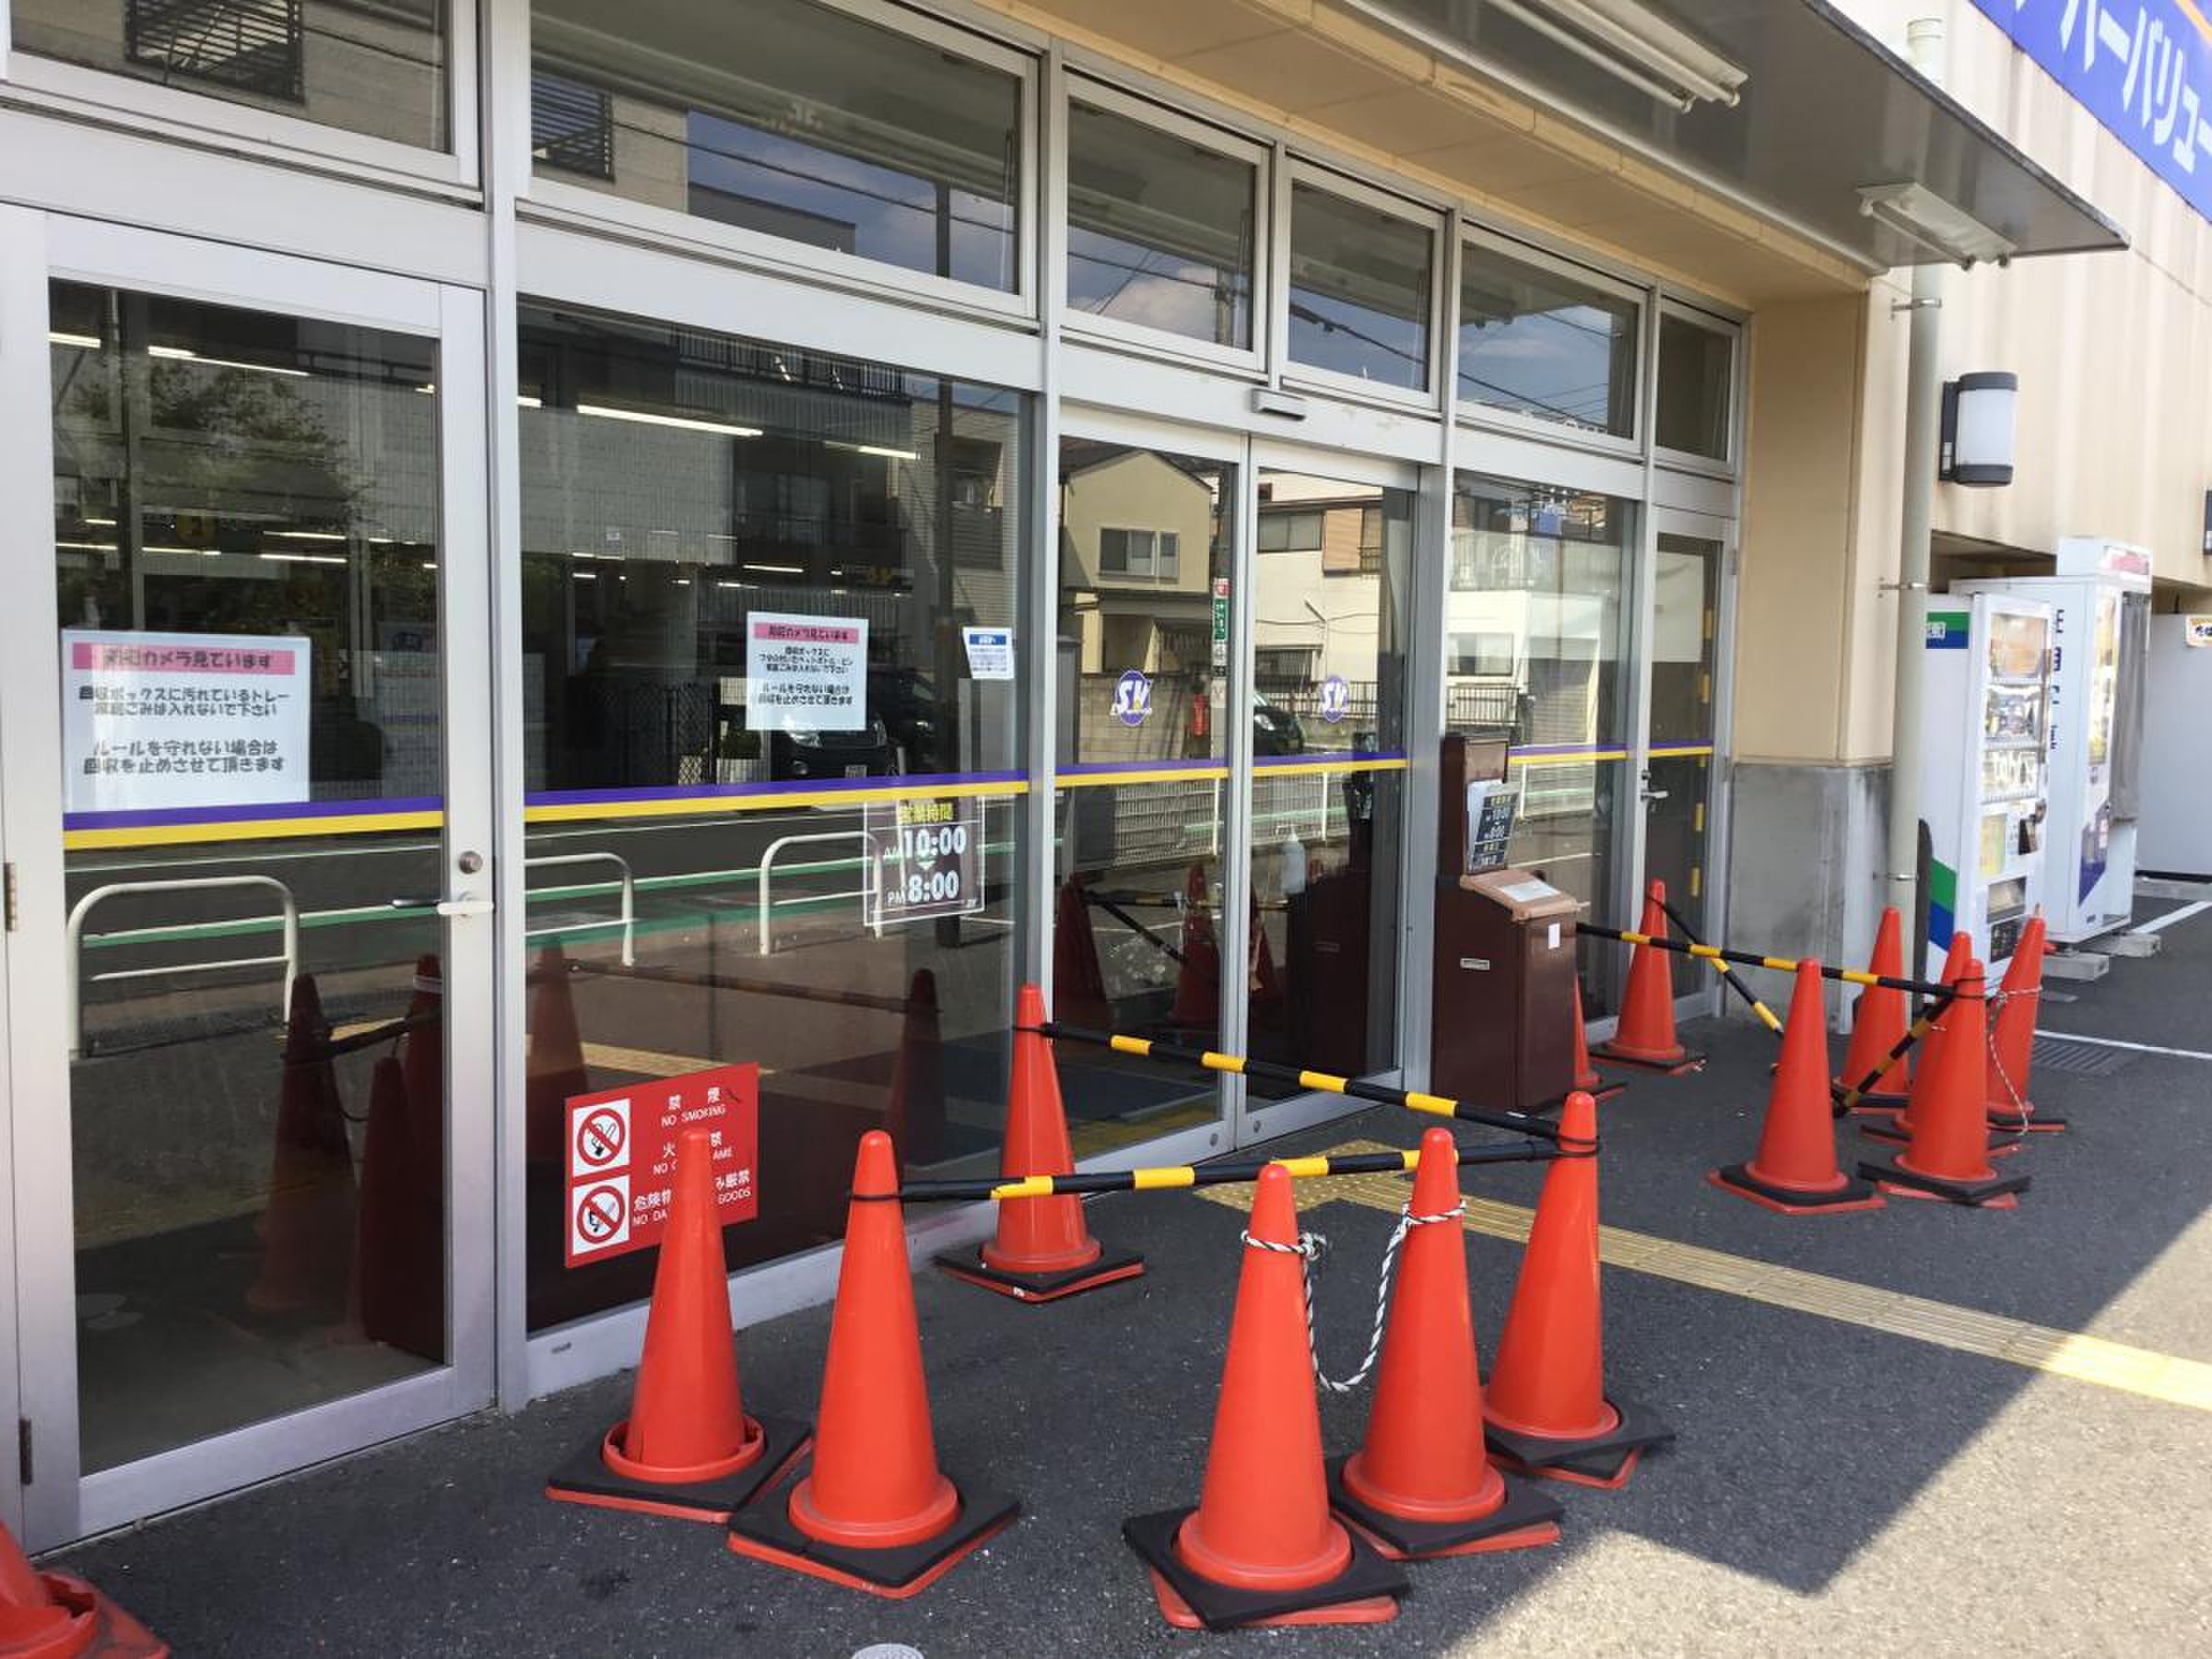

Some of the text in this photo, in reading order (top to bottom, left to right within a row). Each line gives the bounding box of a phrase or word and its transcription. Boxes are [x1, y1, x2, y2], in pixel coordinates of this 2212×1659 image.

[904, 825, 967, 858] 10:00
[908, 869, 959, 903] 8:00
[661, 1103, 726, 1127] NO SMOKING
[653, 1162, 668, 1175] NO
[633, 1214, 648, 1226] NO
